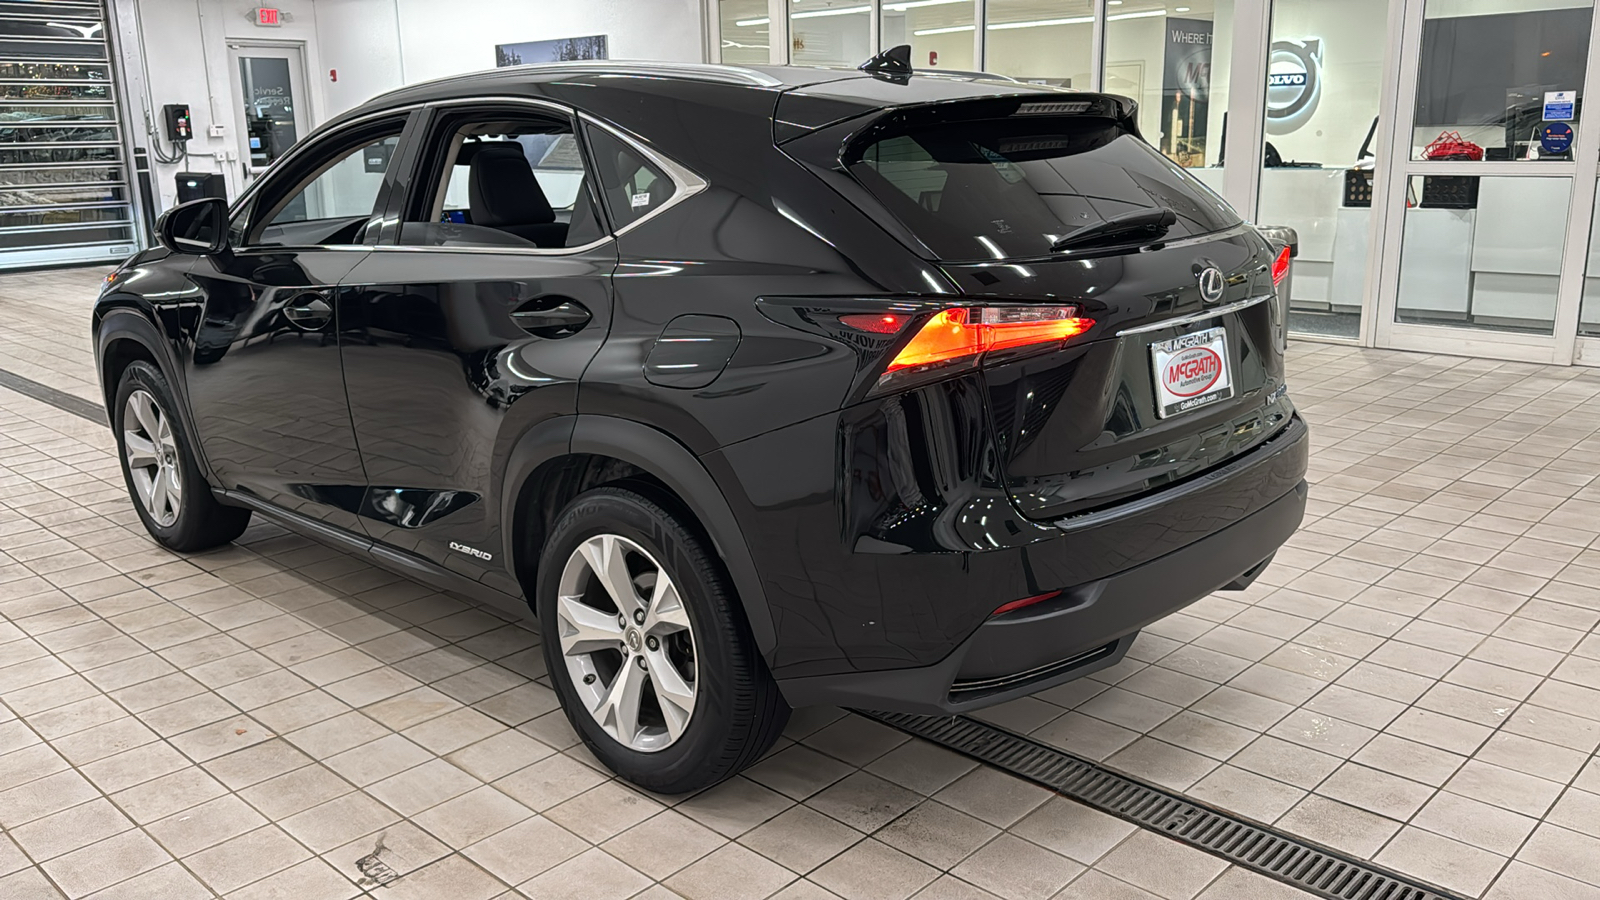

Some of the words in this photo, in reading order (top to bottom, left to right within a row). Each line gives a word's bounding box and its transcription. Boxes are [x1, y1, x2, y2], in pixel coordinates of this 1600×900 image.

[260, 9, 278, 24] EXIT
[1269, 74, 1305, 85] OLVO
[1180, 377, 1201, 387] Automotive
[1201, 373, 1213, 382] Group
[1180, 393, 1218, 410] GoMcGrath.com
[449, 541, 493, 561] HYBRID
